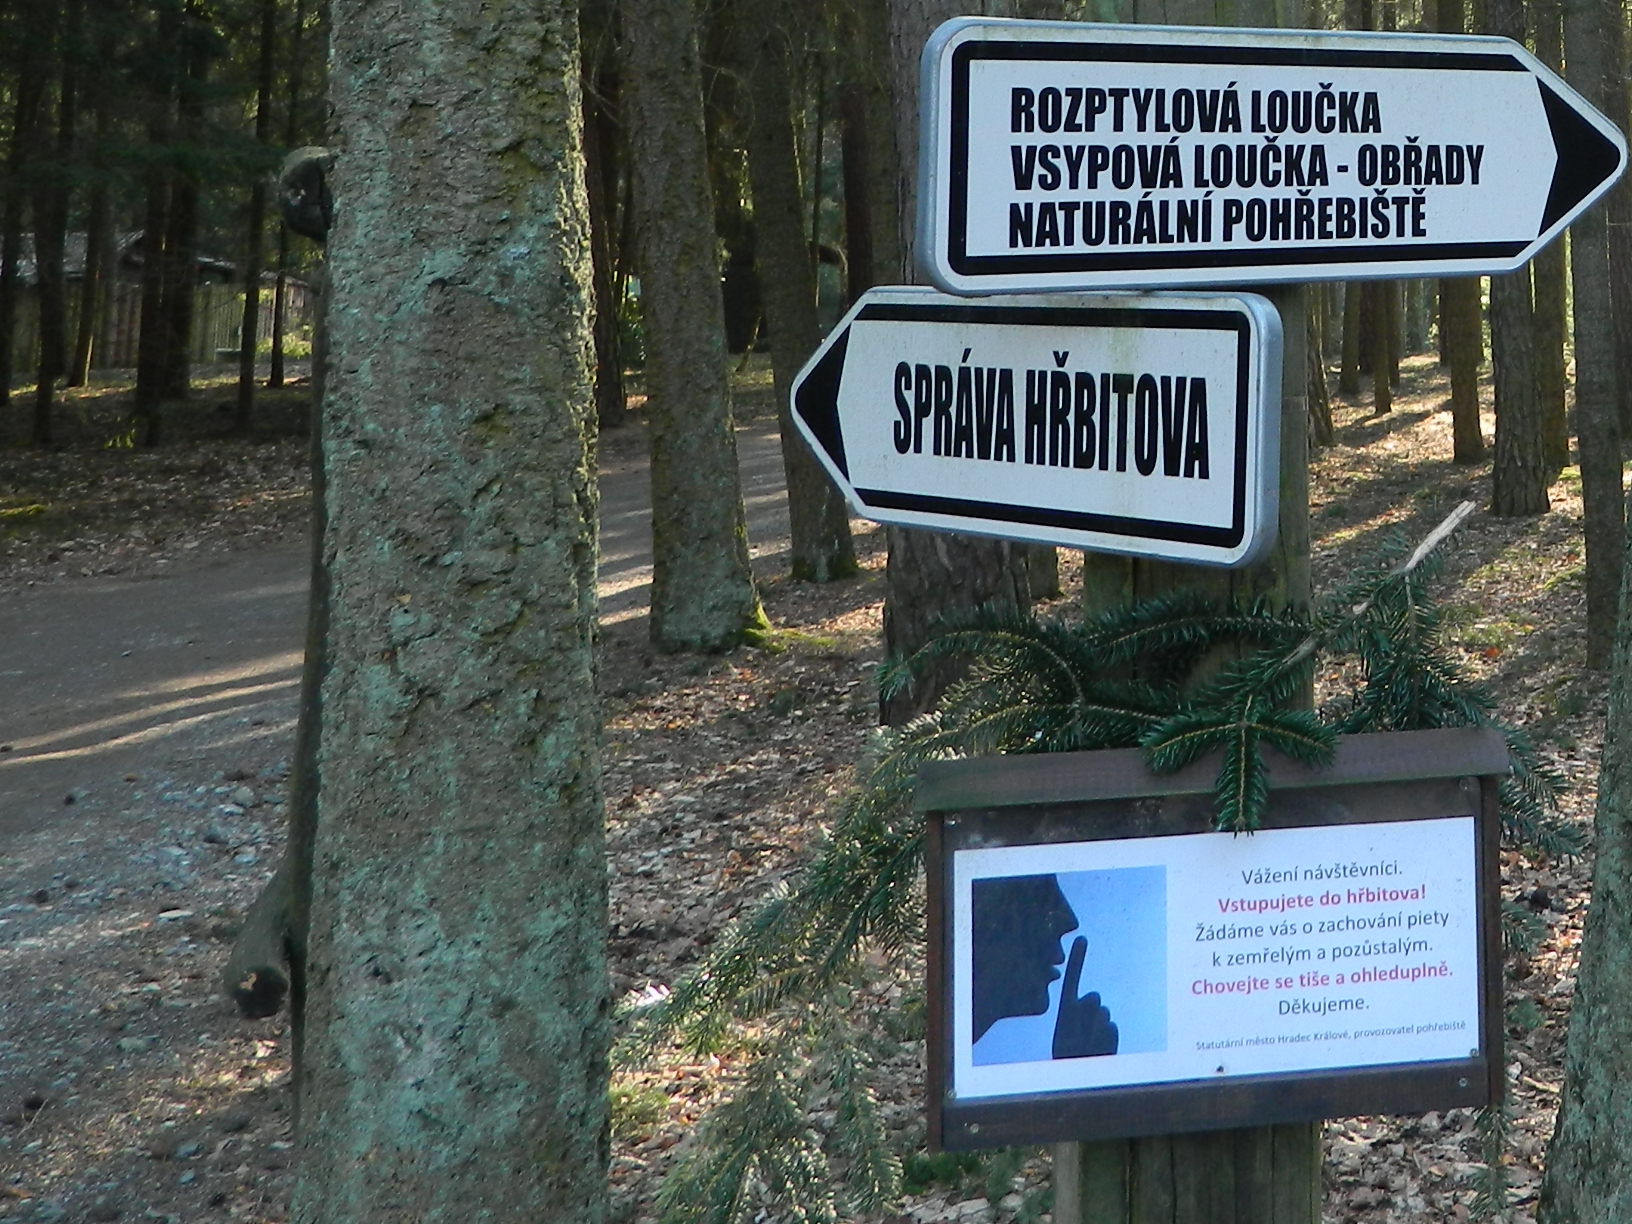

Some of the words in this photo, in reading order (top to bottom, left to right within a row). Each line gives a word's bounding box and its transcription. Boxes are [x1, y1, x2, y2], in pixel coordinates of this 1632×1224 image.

[1011, 81, 1241, 134] ROZPTYLOVÁ
[1250, 82, 1381, 134] LOUČKA
[1011, 136, 1184, 192] VSYPOVÁ
[1193, 136, 1328, 188] LOUČKA
[1337, 164, 1348, 173] -
[1357, 136, 1484, 186] OBŘADY
[1009, 190, 1211, 249] NATURÁLNÍ
[1223, 188, 1427, 242] POHŘEBIŠTĚ
[893, 349, 1014, 463] SPRÁVA
[1024, 351, 1210, 480] HŘBITOVA
[1241, 866, 1298, 885] Vážení
[1218, 893, 1314, 914] Vstupujete
[1319, 891, 1341, 906] do
[1347, 884, 1426, 904] hřbitova!
[1195, 922, 1264, 942] Žádáme
[1270, 920, 1297, 936] vás
[1302, 923, 1313, 935] o
[1318, 911, 1402, 933] zachování
[1407, 910, 1449, 928] piety
[1212, 951, 1221, 967] k
[1227, 946, 1311, 966] zemřelým
[1317, 949, 1326, 960] a
[1332, 938, 1433, 962] pozůstalým.
[1191, 976, 1270, 995] Chovejte
[1275, 977, 1294, 989] se
[1300, 970, 1330, 987] tiše
[1336, 974, 1345, 985] a
[1350, 961, 1453, 983] ohleduplně.
[1278, 997, 1370, 1016] Děkujeme.
